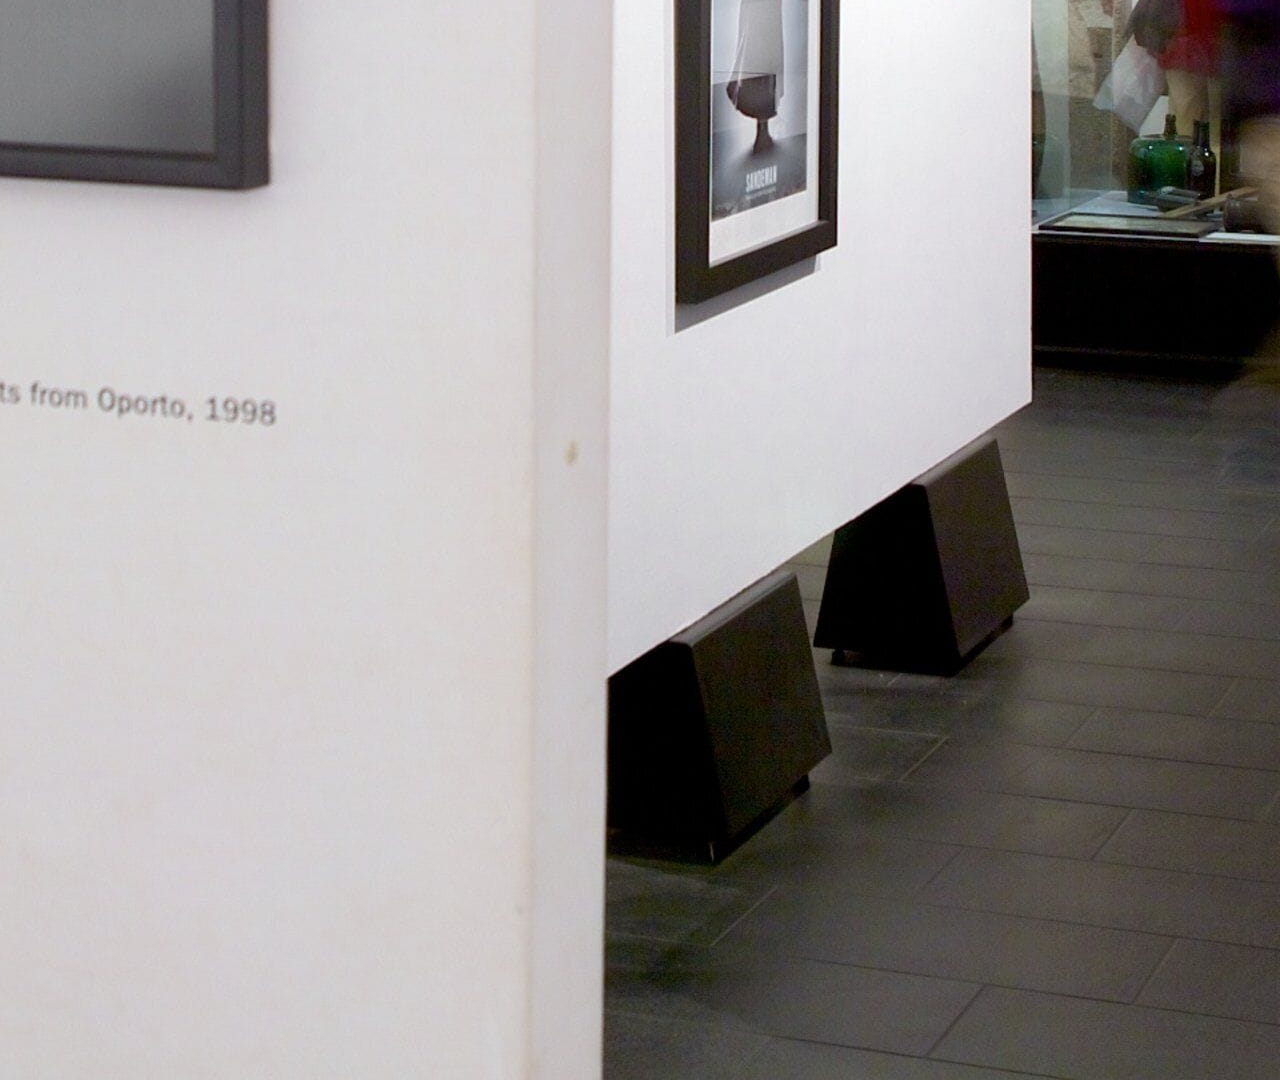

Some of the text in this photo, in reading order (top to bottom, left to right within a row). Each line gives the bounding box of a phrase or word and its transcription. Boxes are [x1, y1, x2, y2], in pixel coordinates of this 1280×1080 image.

[30, 381, 89, 408] from
[96, 386, 195, 422] Oporto,
[205, 396, 278, 426] 1998
